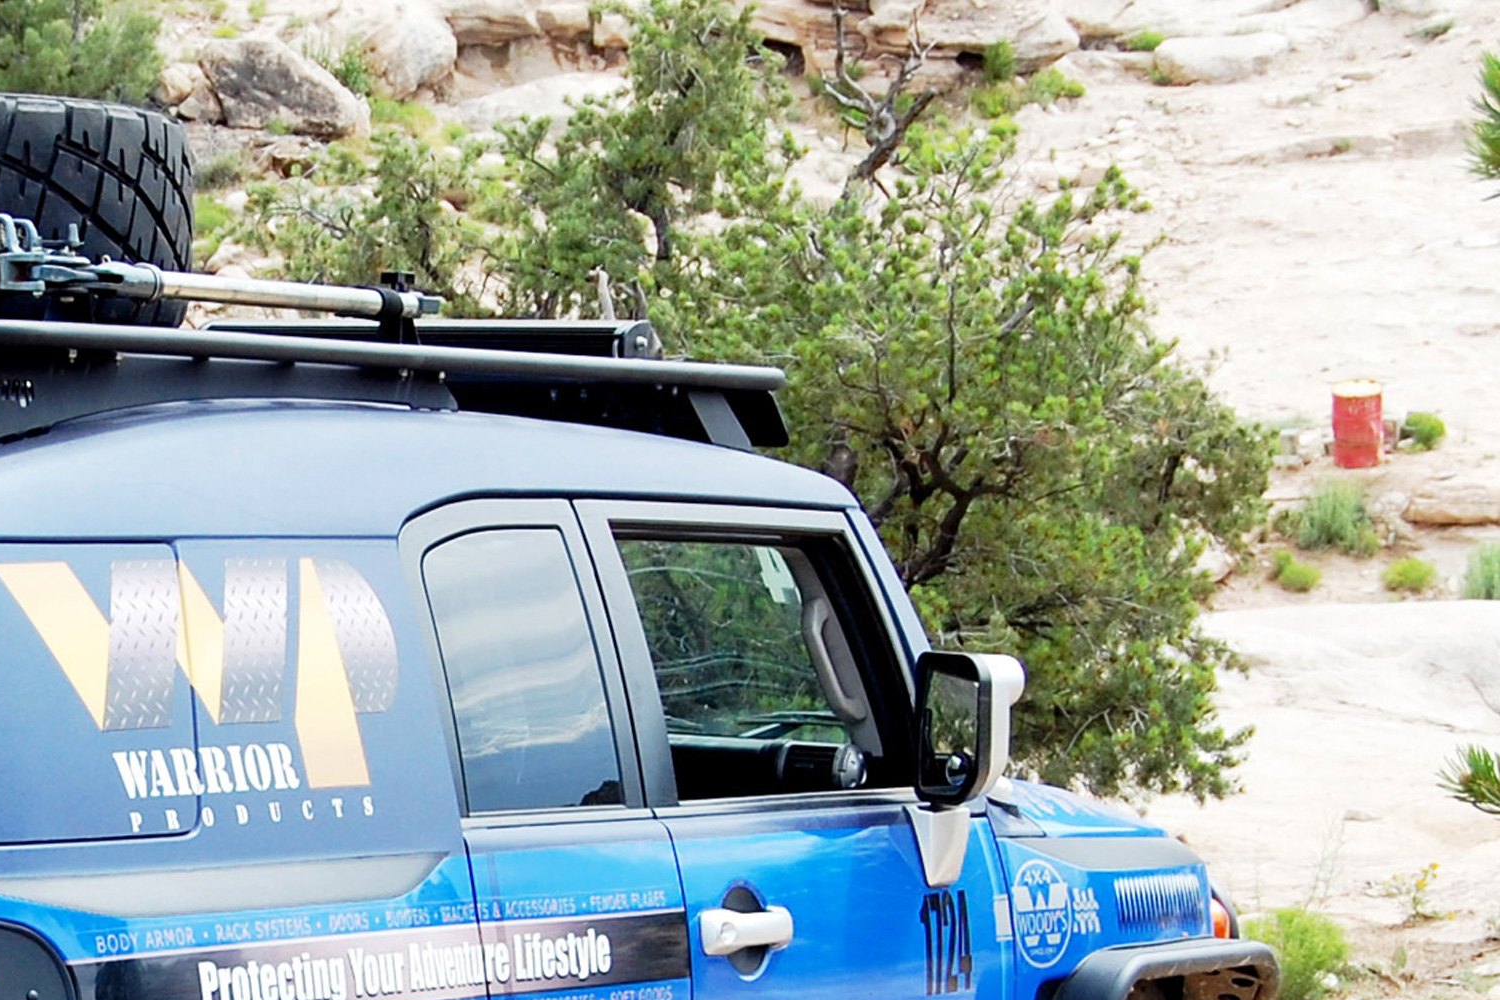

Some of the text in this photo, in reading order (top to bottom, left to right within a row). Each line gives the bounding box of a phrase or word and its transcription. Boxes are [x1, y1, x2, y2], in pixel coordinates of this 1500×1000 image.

[112, 743, 300, 800] WARRIOR
[129, 796, 374, 833] PRODUCTS
[96, 932, 138, 954] BODY
[146, 927, 196, 949] ARMOR
[215, 922, 252, 942] RACK
[255, 917, 312, 938] SYSTEMS
[328, 912, 369, 933] DOORS
[505, 896, 576, 918] ACCESSORIES
[919, 889, 972, 996] 1724
[1017, 910, 1068, 935] WOODY'S
[349, 945, 404, 997] Your
[408, 940, 510, 993] Adventure
[514, 928, 612, 983] Lifestyle
